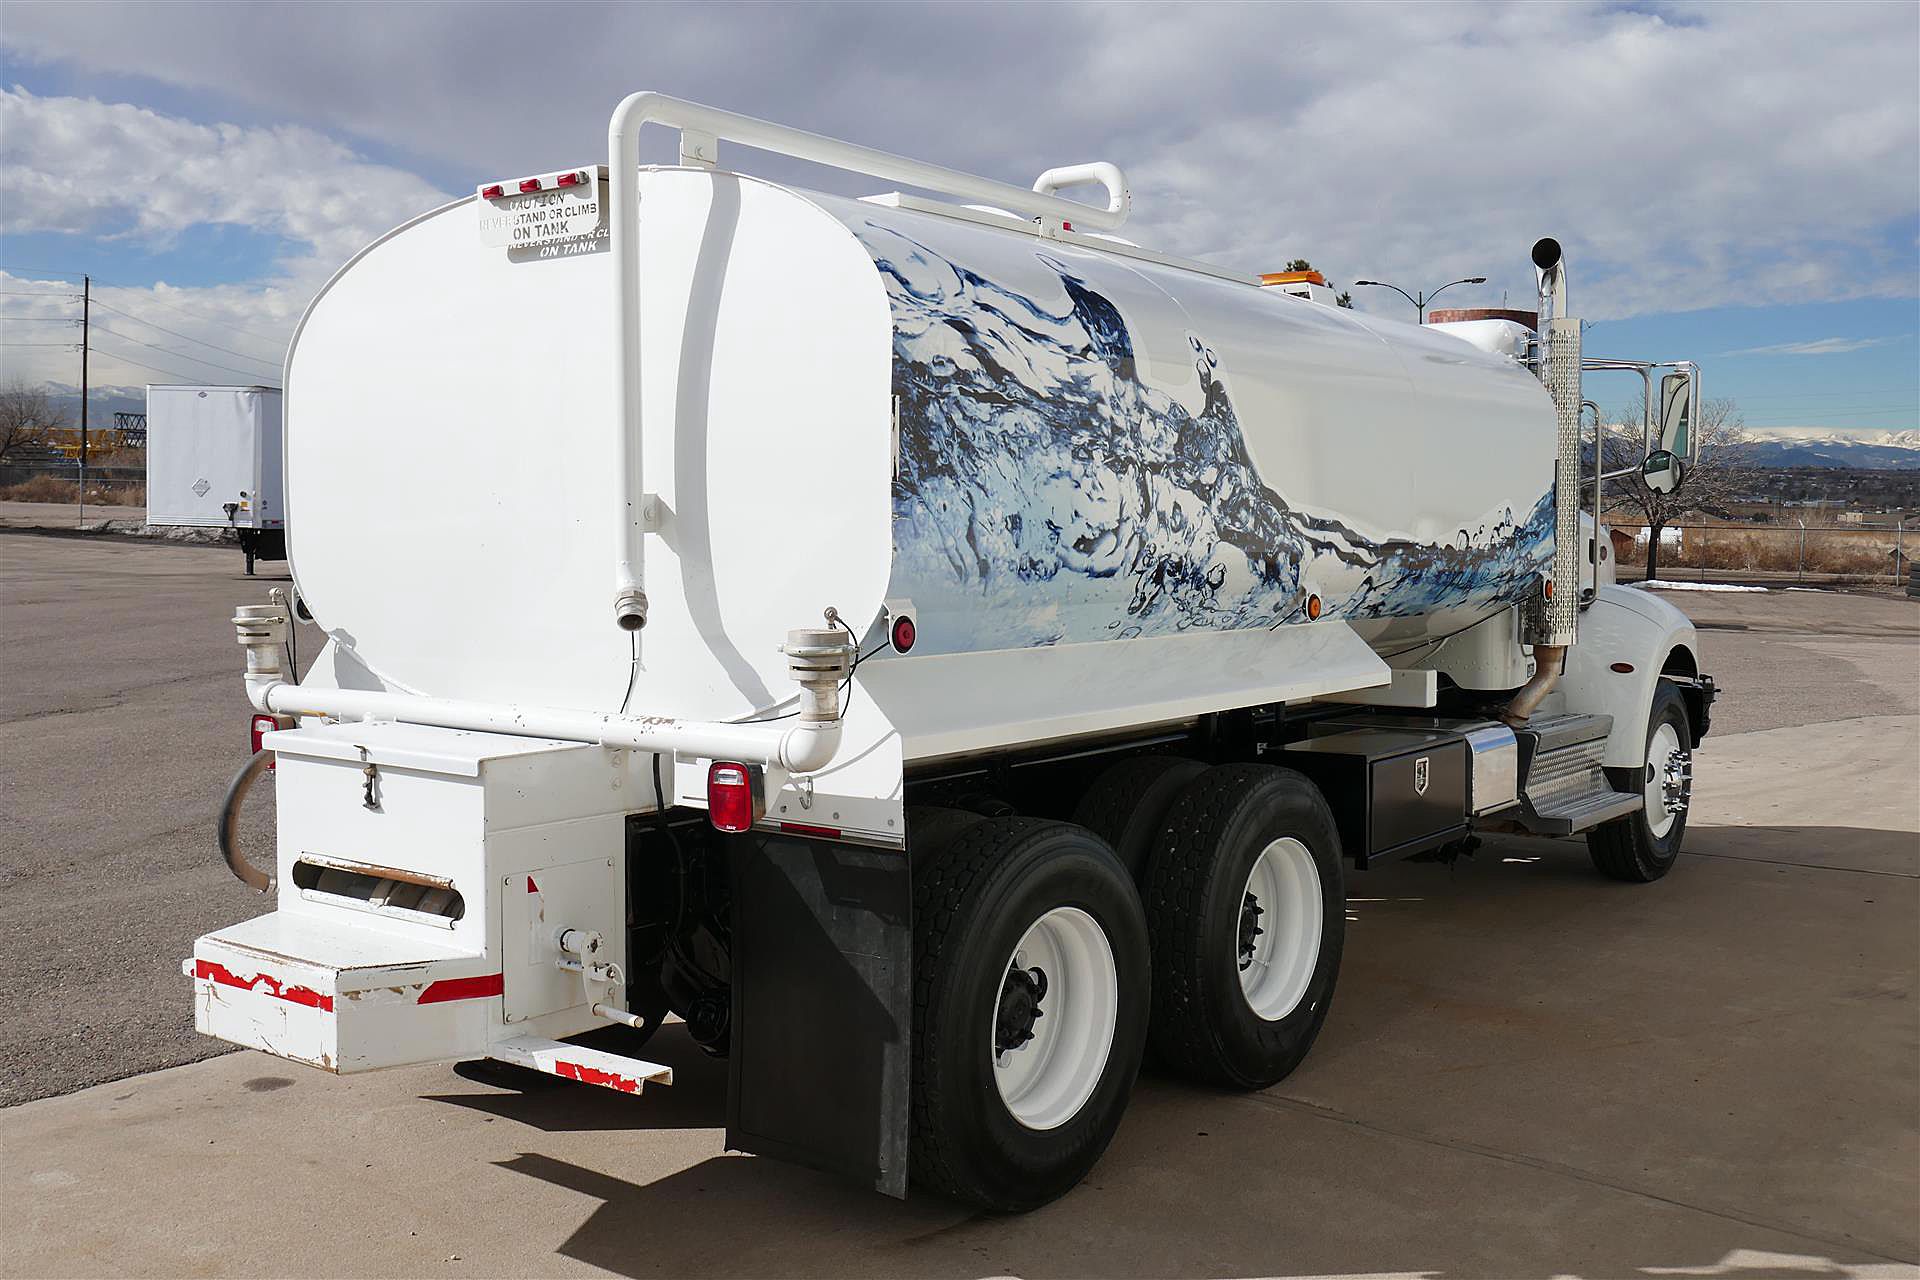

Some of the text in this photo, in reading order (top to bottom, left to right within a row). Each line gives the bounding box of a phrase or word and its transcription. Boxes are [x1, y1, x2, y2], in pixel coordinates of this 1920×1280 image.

[513, 211, 546, 225] STAND
[549, 208, 563, 219] OR
[564, 202, 597, 217] CLIMB
[513, 220, 569, 240] ON TANK
[540, 240, 598, 258] ON TANK
